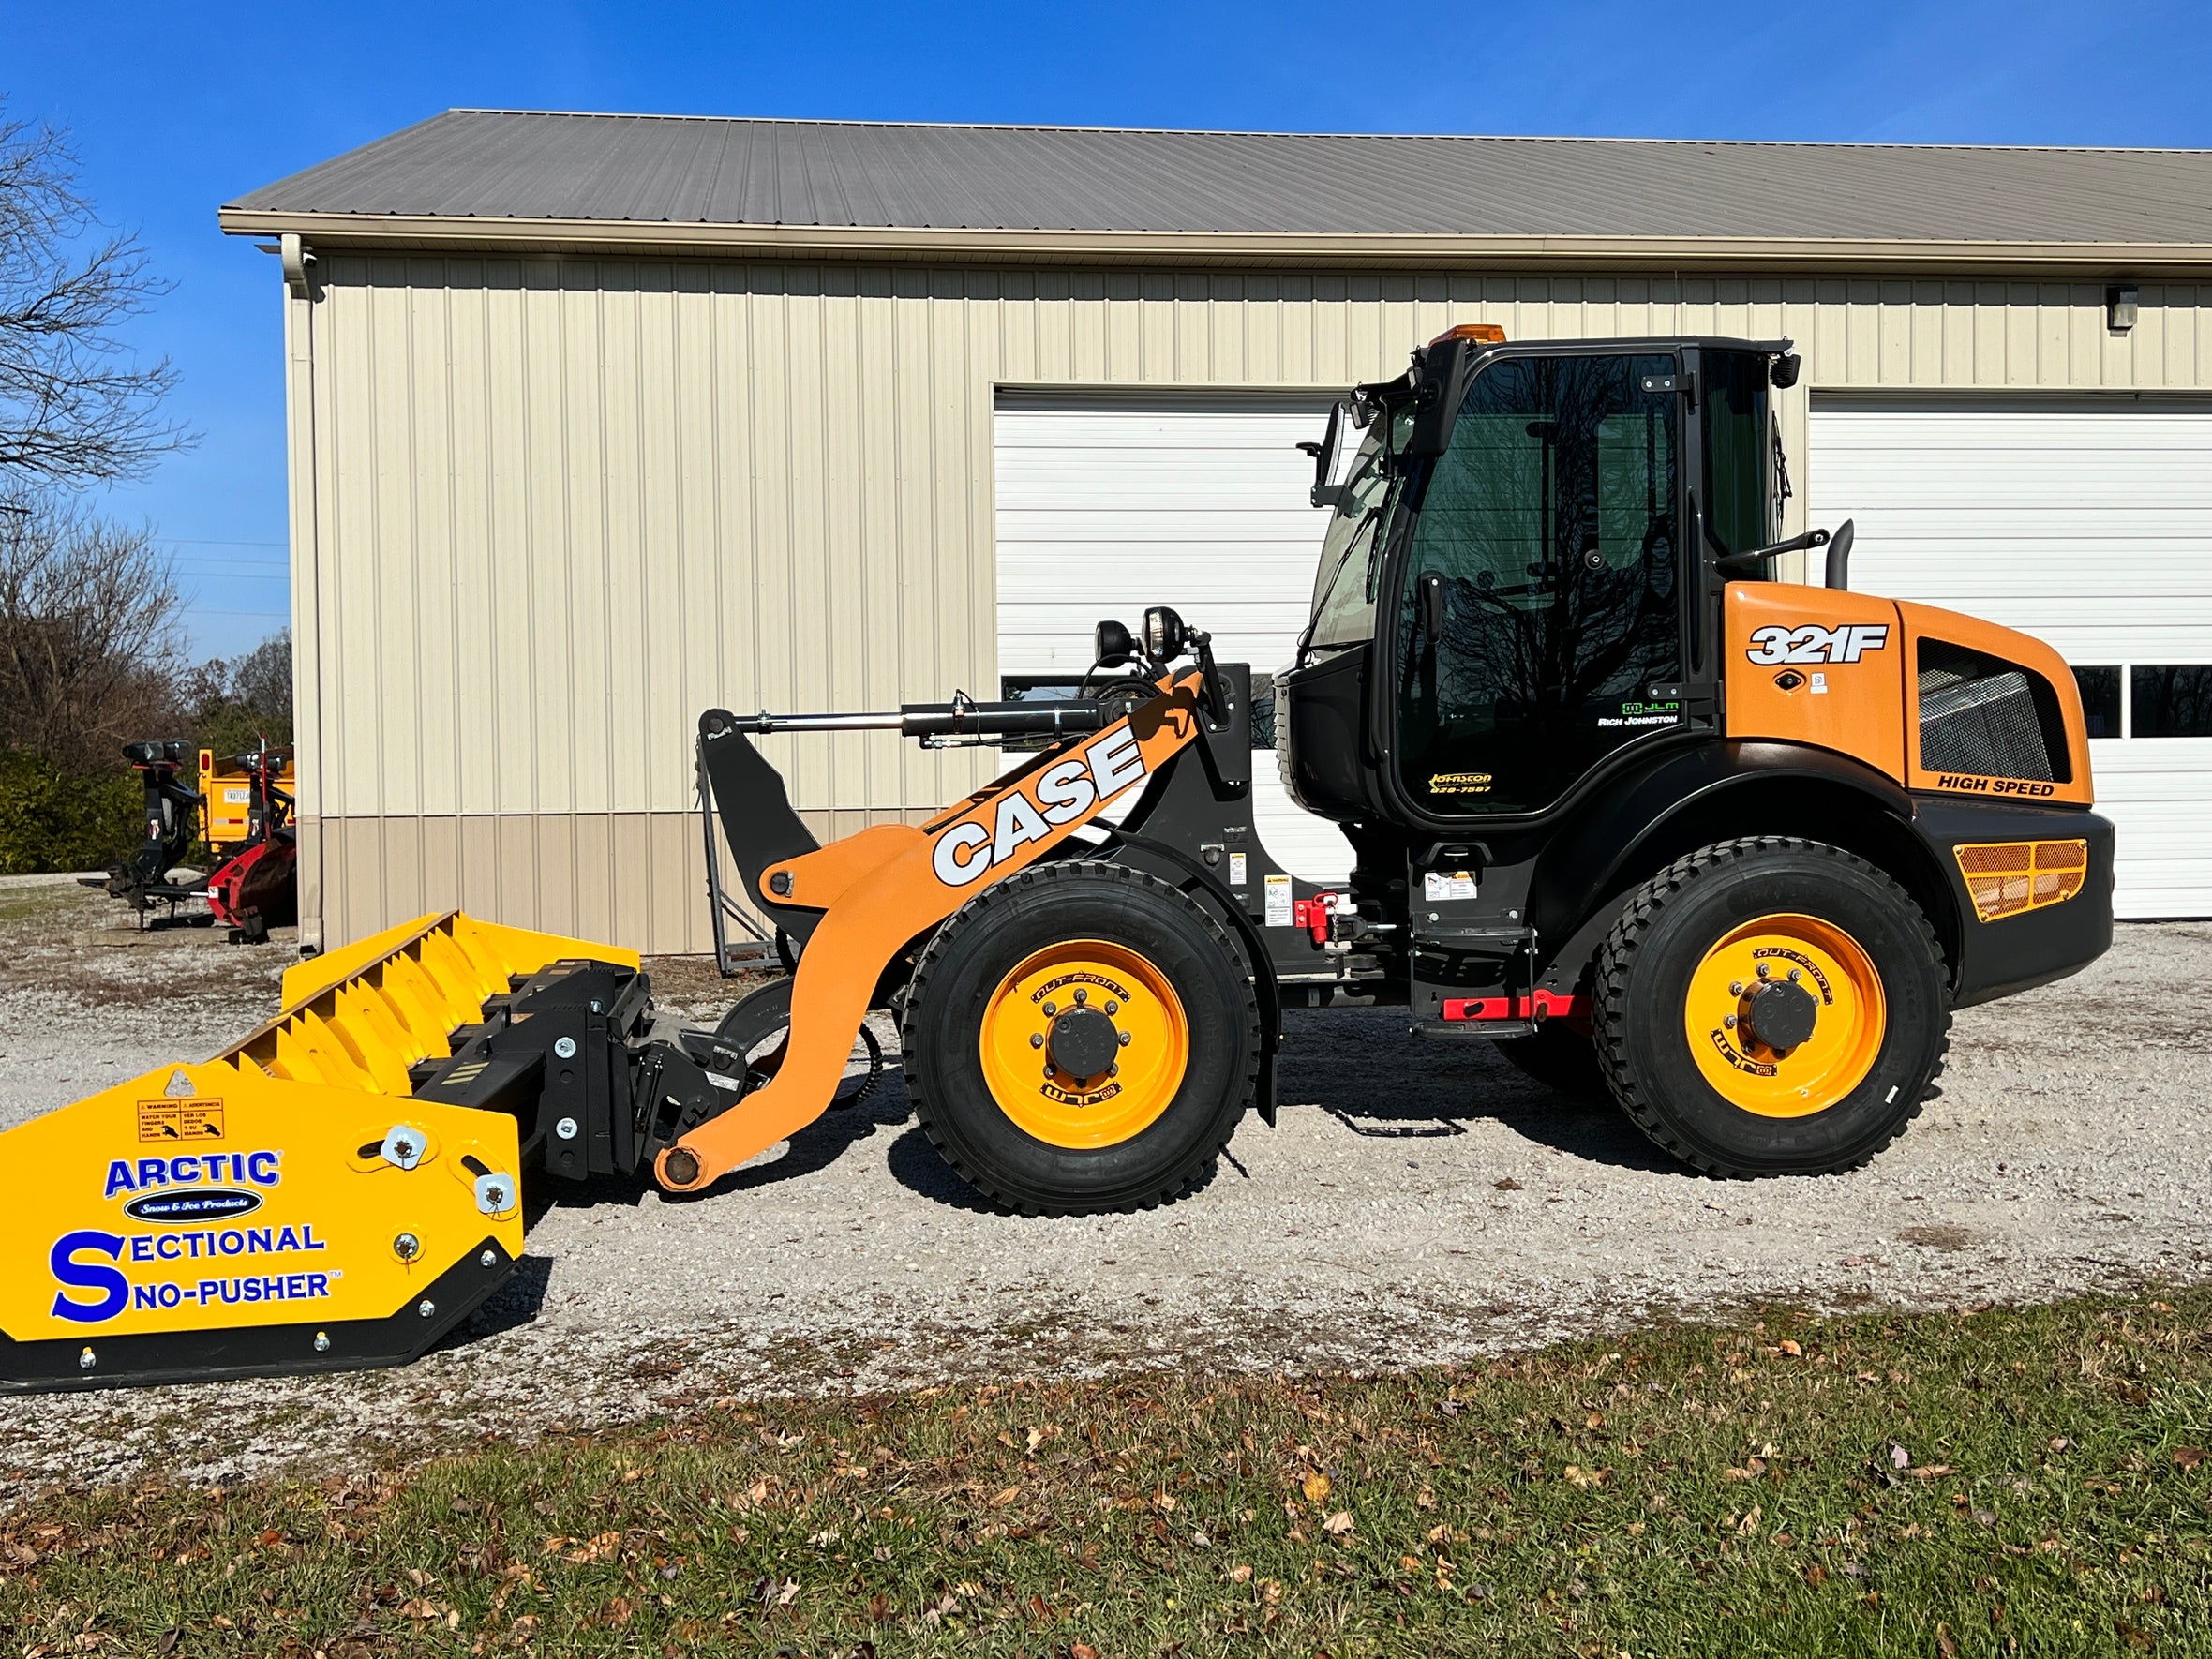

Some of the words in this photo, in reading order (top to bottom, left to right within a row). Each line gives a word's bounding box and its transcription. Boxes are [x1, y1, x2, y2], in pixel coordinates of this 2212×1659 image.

[1746, 624, 1890, 666] 321F
[1624, 715, 1678, 725] JOHNSTON
[1937, 775, 1988, 791] HIGH
[1993, 780, 2055, 797] SPEED
[932, 723, 1147, 887] CASE
[1035, 973, 1128, 1000] OUT-FRONT
[1756, 948, 1832, 999] OUT-FRONT
[141, 1203, 171, 1214] Snow
[171, 1203, 181, 1212] &
[182, 1202, 200, 1211] Ice
[202, 1199, 248, 1209] Products
